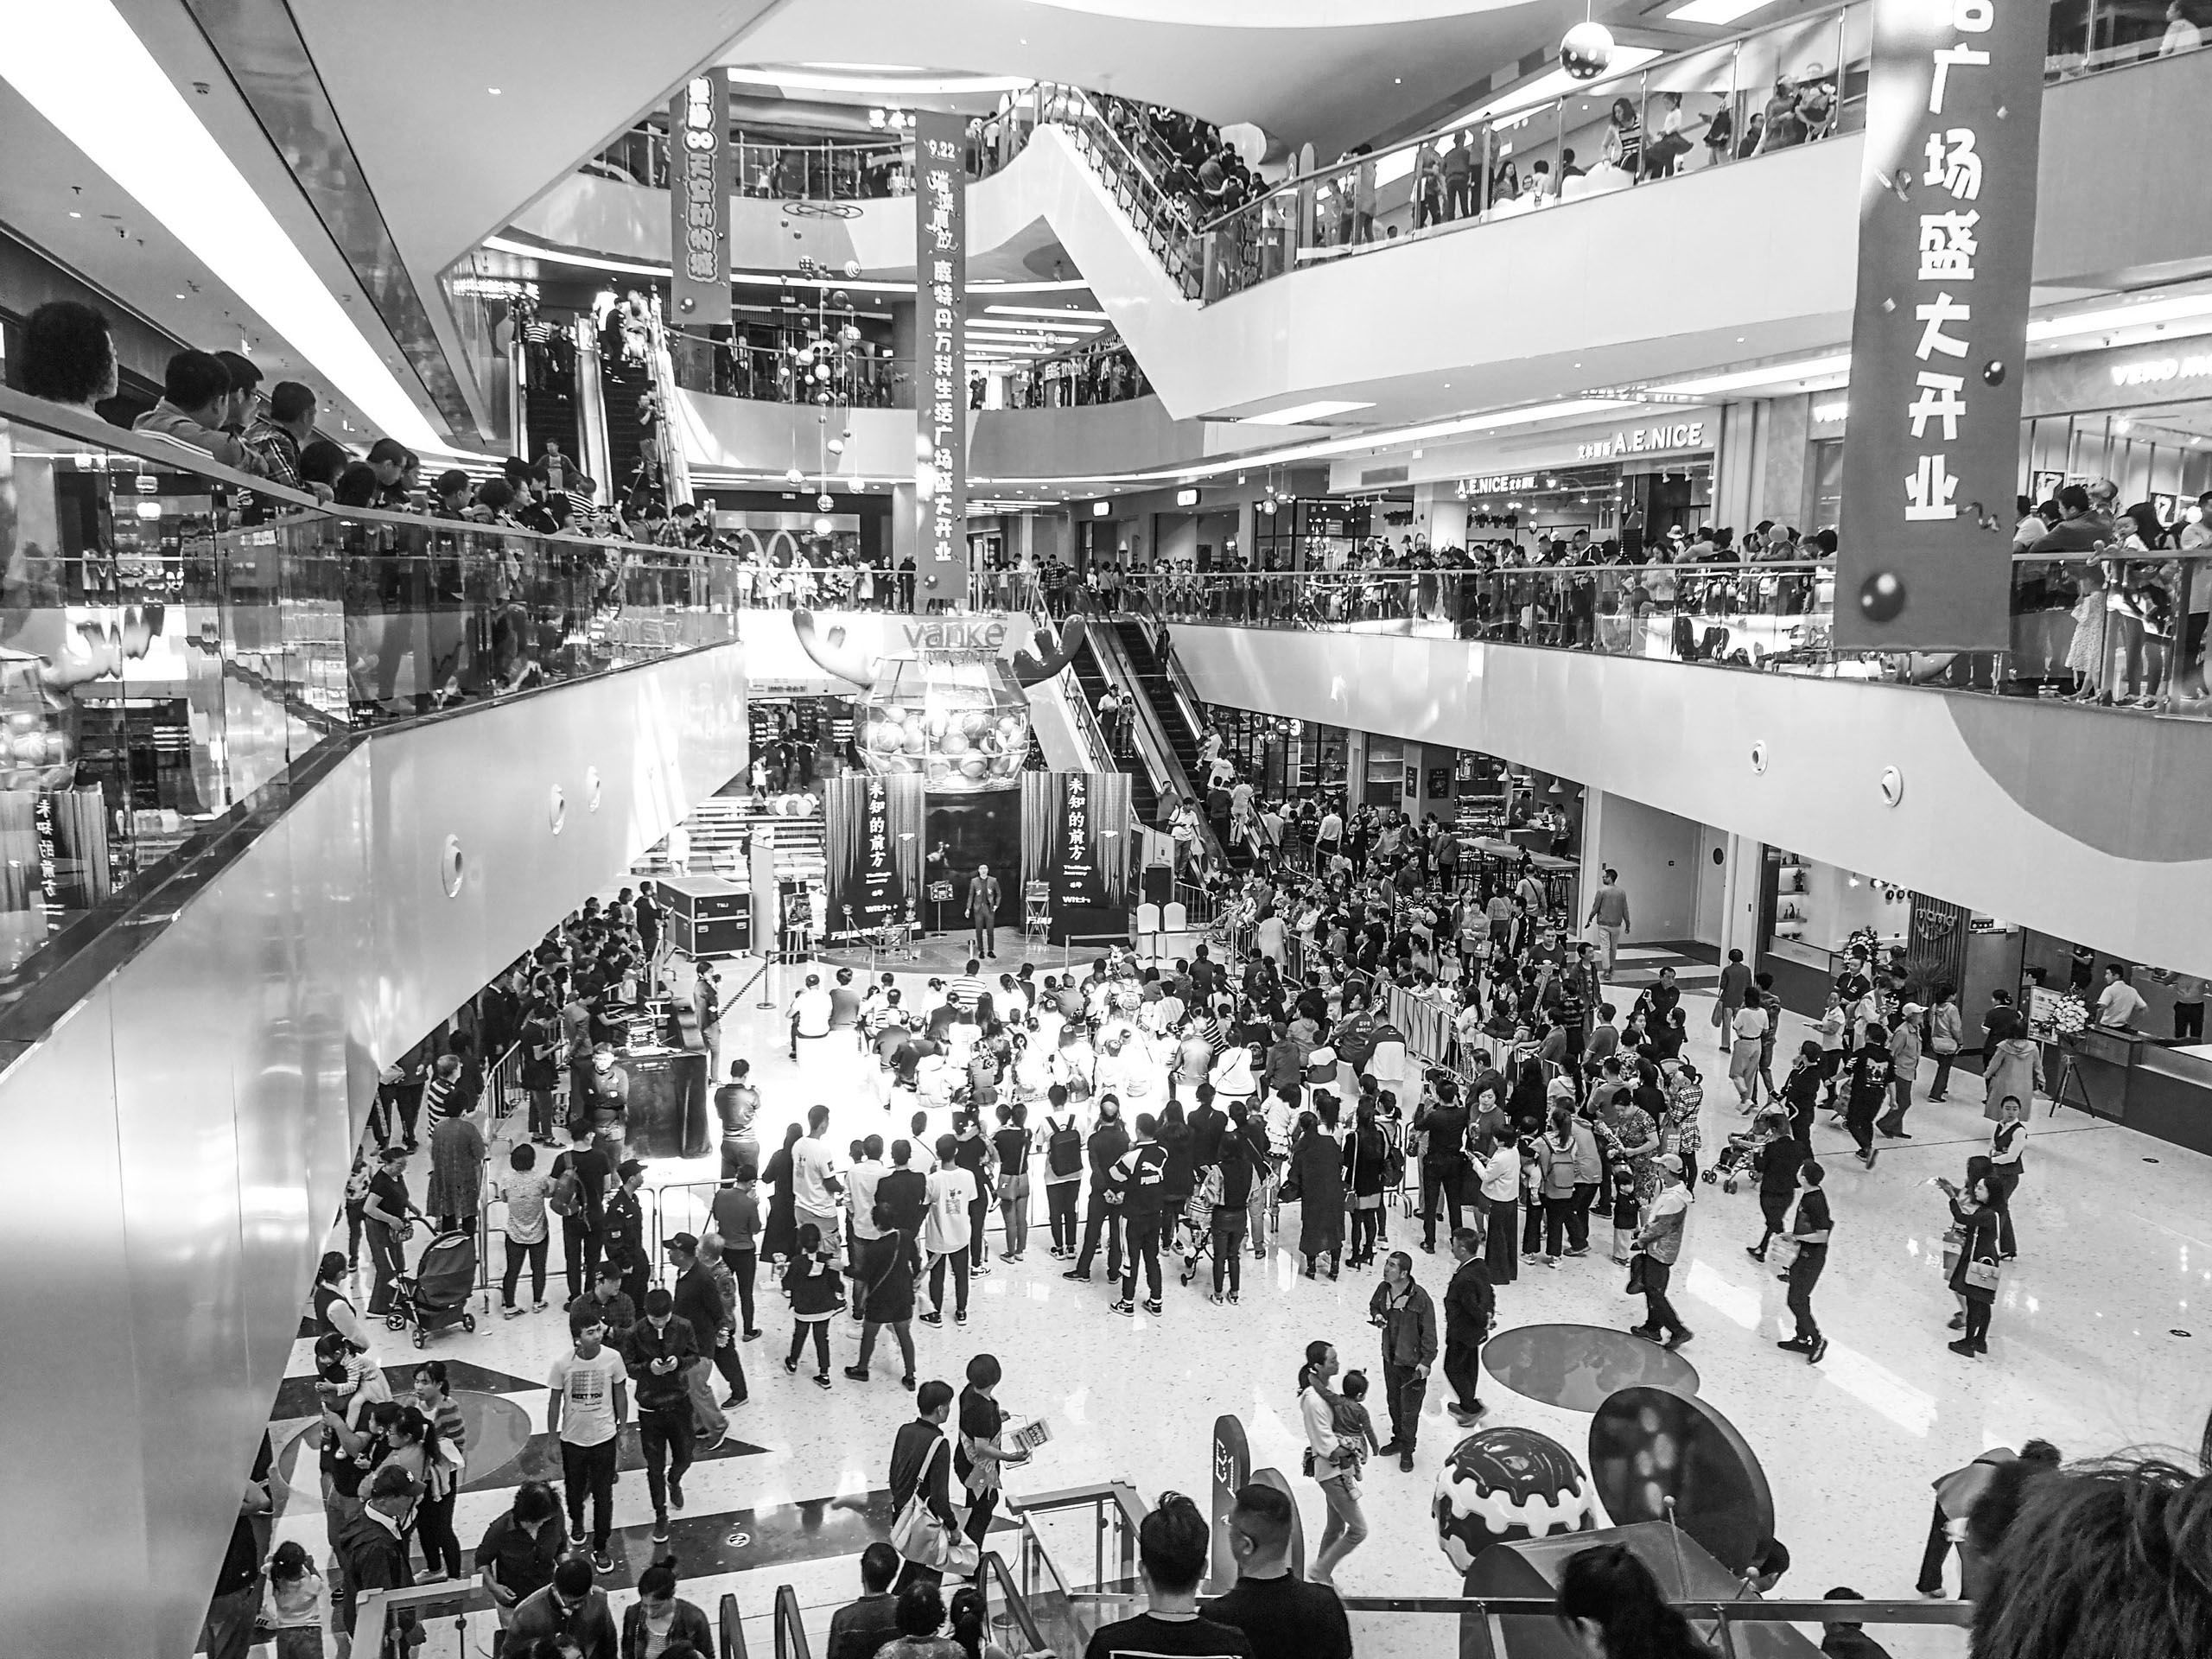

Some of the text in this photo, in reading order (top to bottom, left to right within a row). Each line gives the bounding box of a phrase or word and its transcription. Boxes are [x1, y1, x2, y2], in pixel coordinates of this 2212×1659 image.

[1614, 423, 1703, 454] A.E.NICE
[1458, 476, 1509, 494] A.E.NICE
[902, 621, 1006, 648] vanke
[868, 781, 887, 868] 未知的前方
[1068, 778, 1085, 861] 未知的前方
